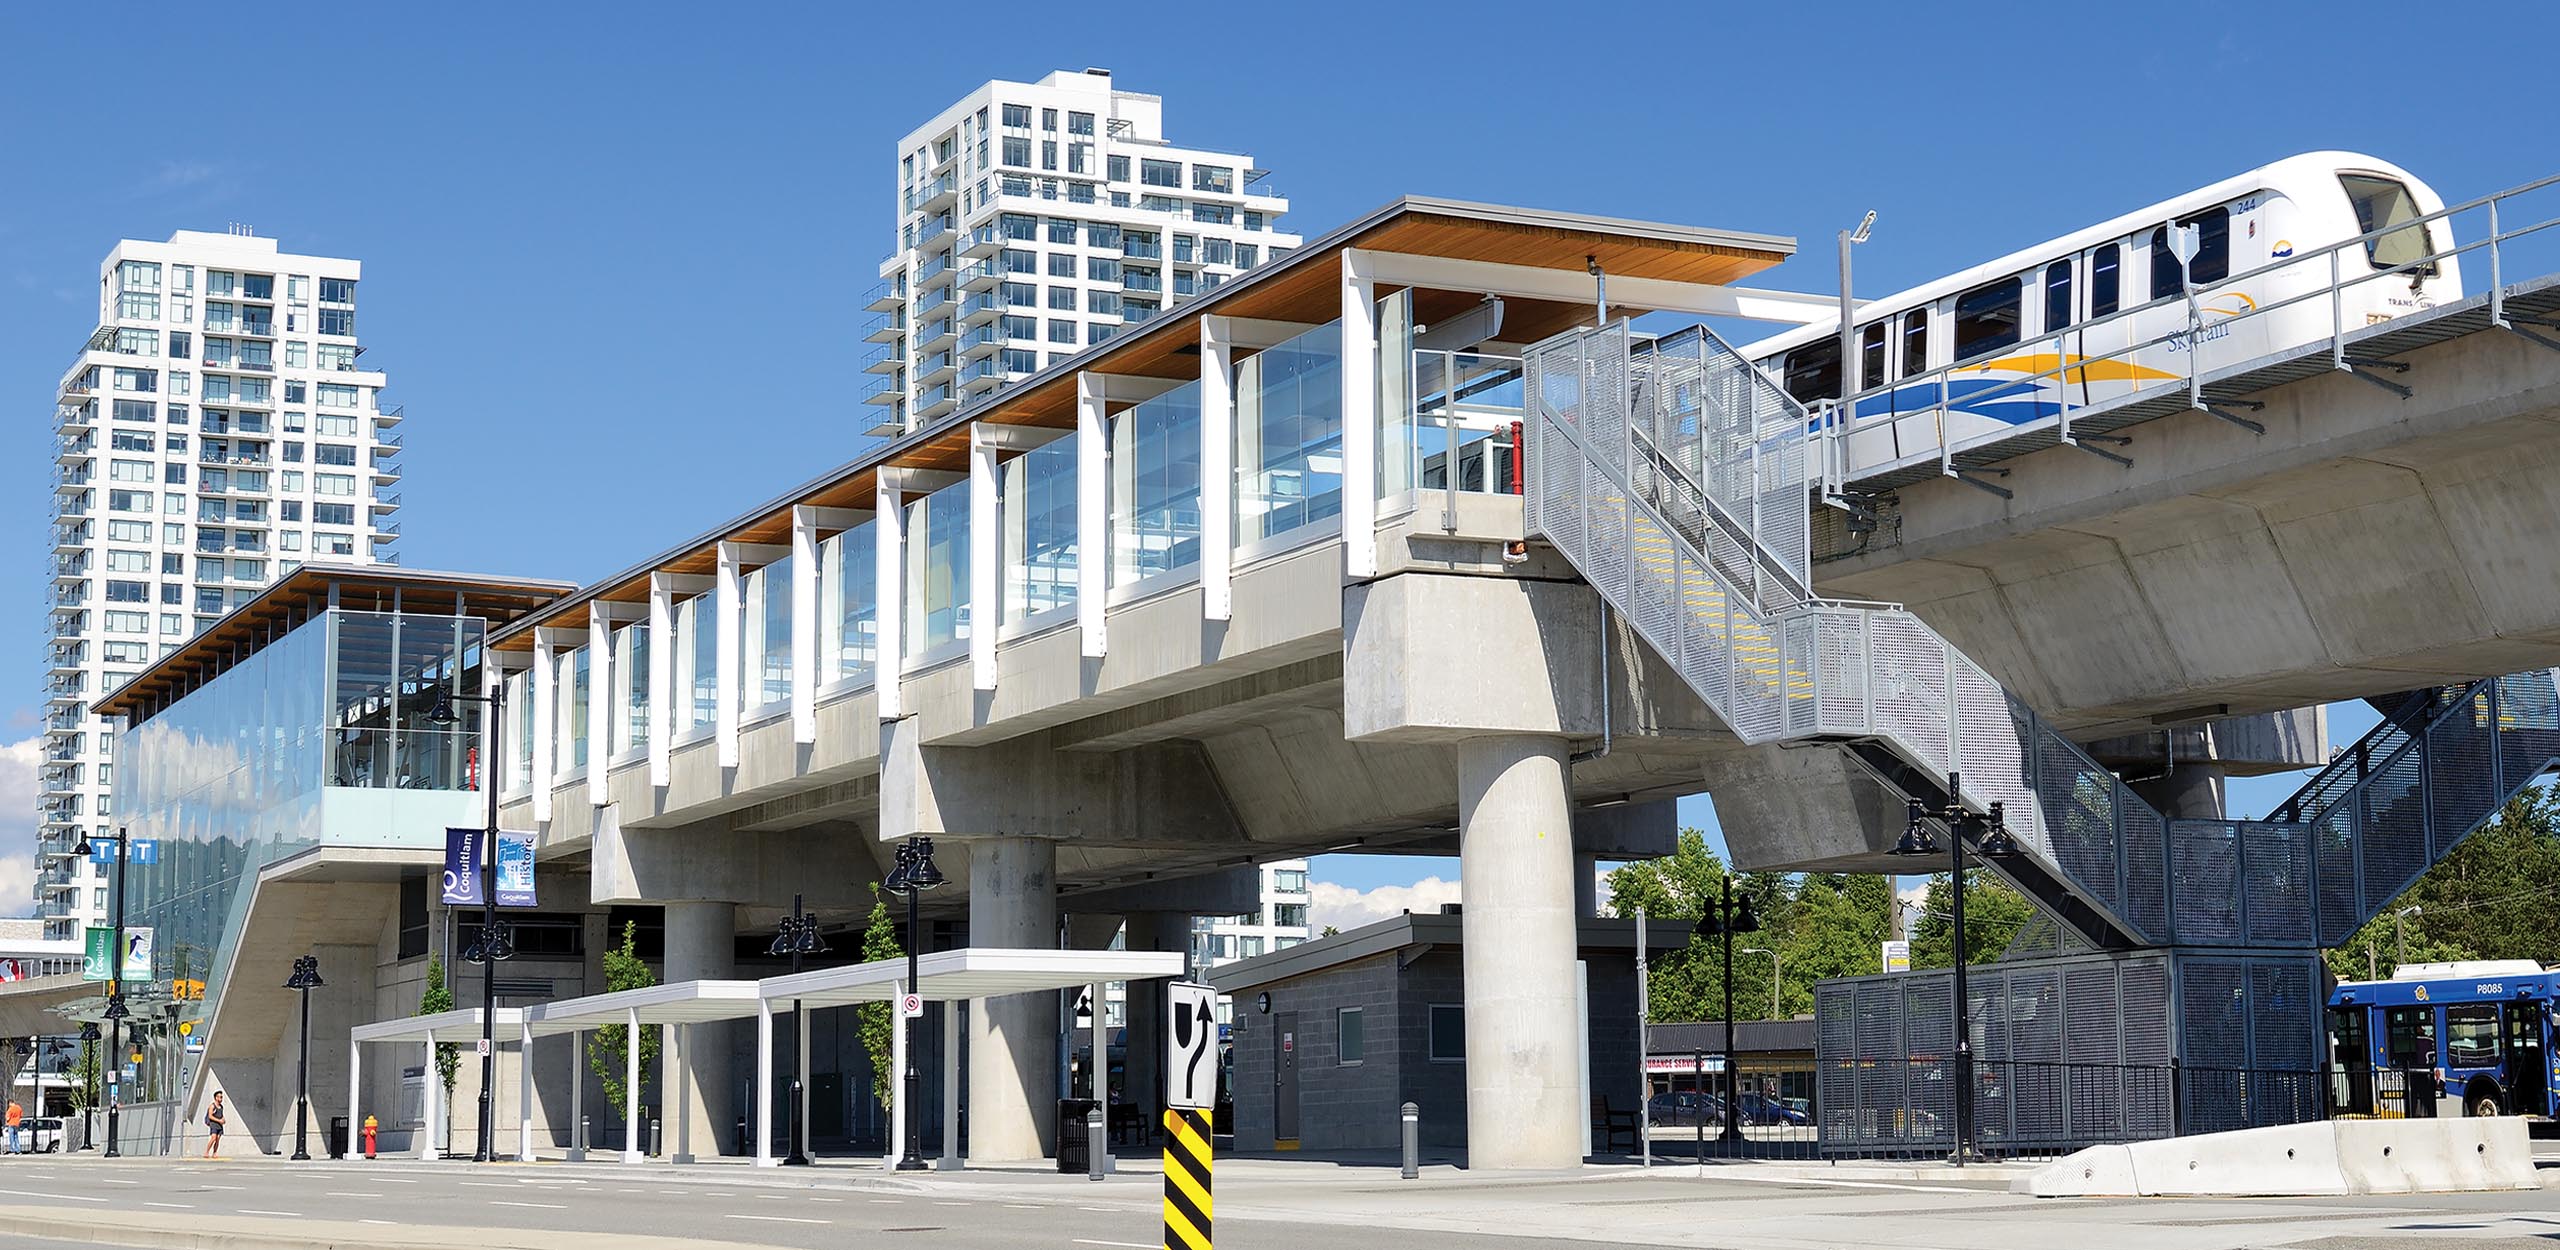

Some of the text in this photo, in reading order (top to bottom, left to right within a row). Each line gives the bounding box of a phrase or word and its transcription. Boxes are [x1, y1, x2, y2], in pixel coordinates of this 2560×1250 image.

[2237, 198, 2256, 215] 244
[2388, 298, 2413, 307] TRANS
[2167, 319, 2229, 352] Skyrain
[96, 842, 110, 860] T
[136, 843, 151, 860] T
[460, 833, 473, 893] Coquitlam
[520, 838, 534, 886] Historic
[96, 930, 105, 972] Coquitlam
[2477, 983, 2503, 995] P8085
[1674, 1058, 1705, 1069] SERVICS
